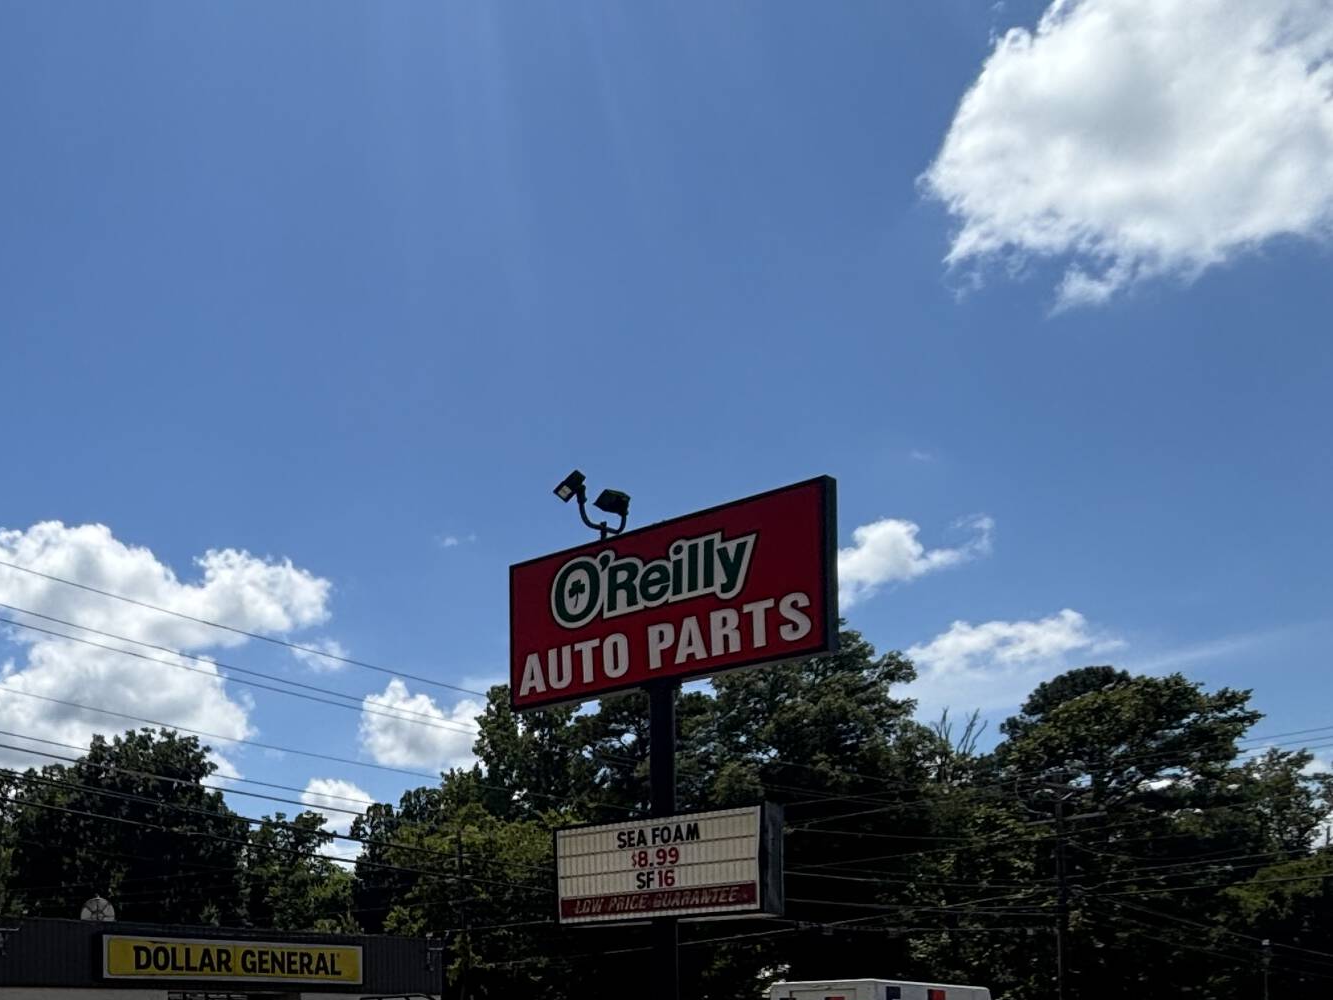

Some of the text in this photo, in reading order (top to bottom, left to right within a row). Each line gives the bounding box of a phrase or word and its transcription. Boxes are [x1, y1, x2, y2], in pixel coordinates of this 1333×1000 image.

[552, 533, 754, 627] O'Reilly
[519, 592, 812, 697] AUTO PARTS
[617, 822, 700, 849] SEA FOAM
[631, 846, 680, 869] $8.99
[574, 886, 740, 914] LOW PRICE GUARANTEE
[133, 945, 342, 977] DOLLAR GENERAL
